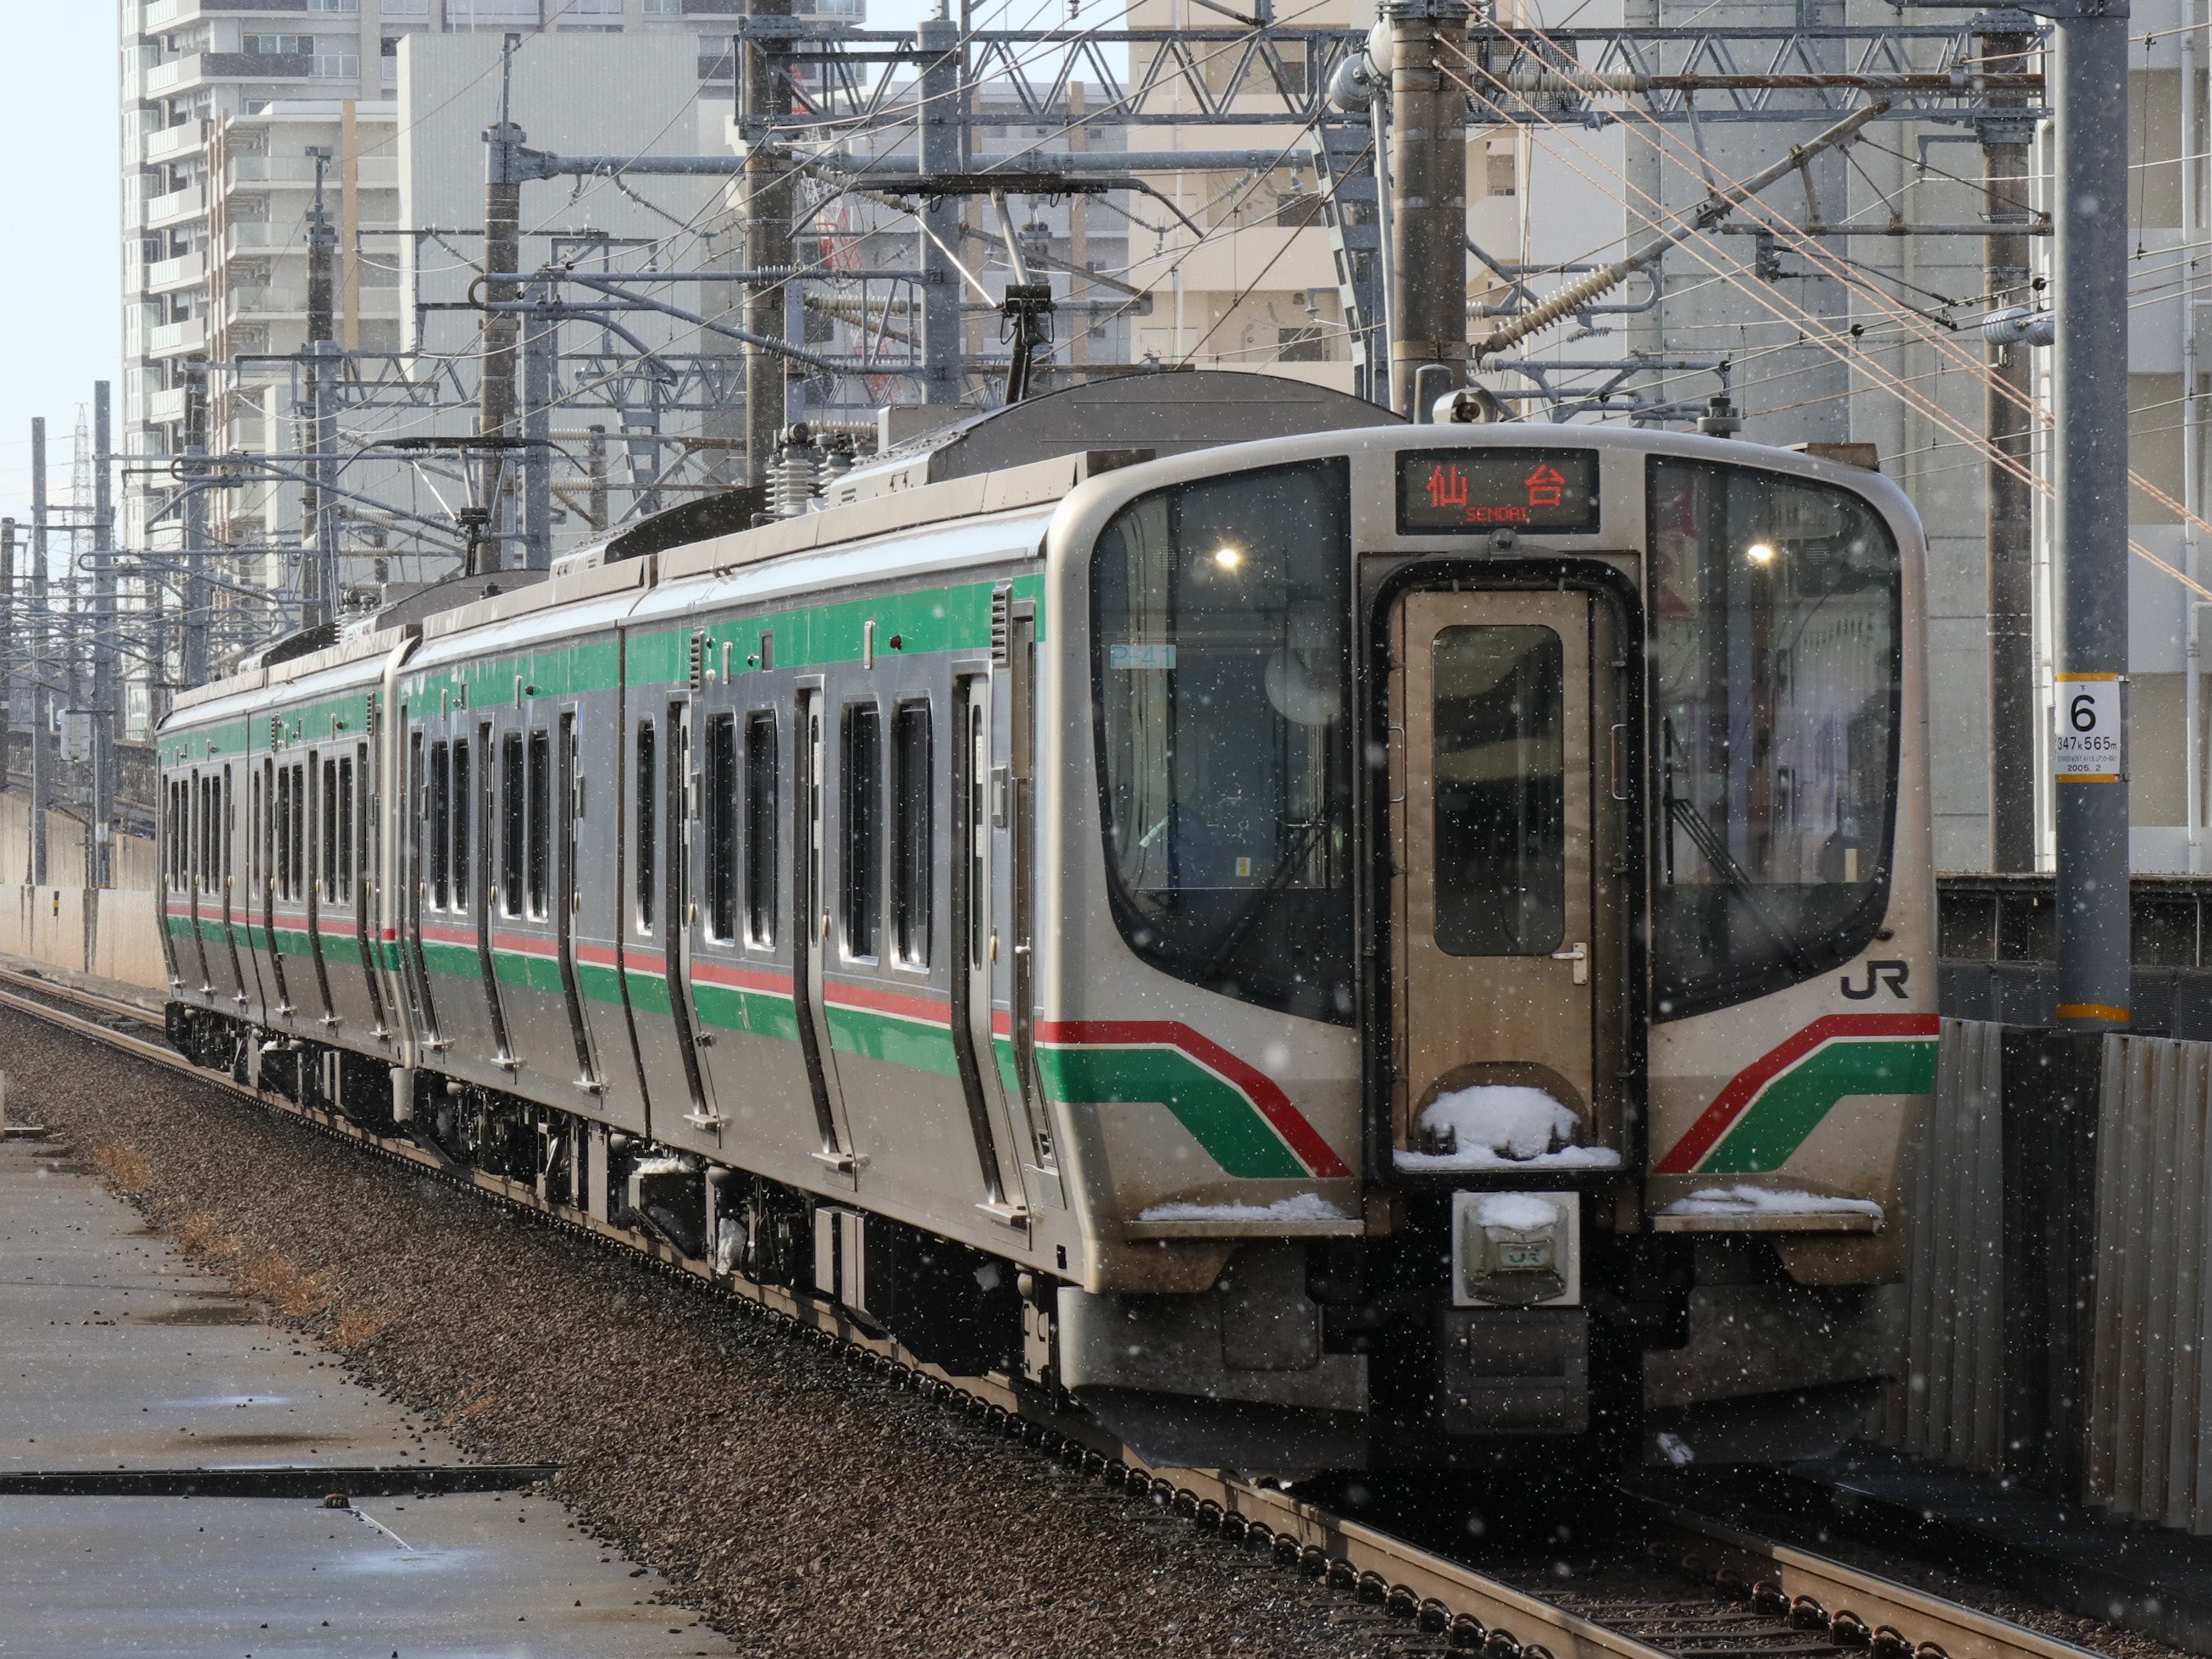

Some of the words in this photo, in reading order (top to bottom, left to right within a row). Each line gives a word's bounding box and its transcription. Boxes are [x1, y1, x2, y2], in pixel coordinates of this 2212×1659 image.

[1466, 508, 1528, 523] SENDAI
[1111, 645, 1171, 668] P-41
[2071, 694, 2097, 732] 6
[1840, 959, 1910, 1000] JR
[1509, 1249, 1541, 1263] JR
